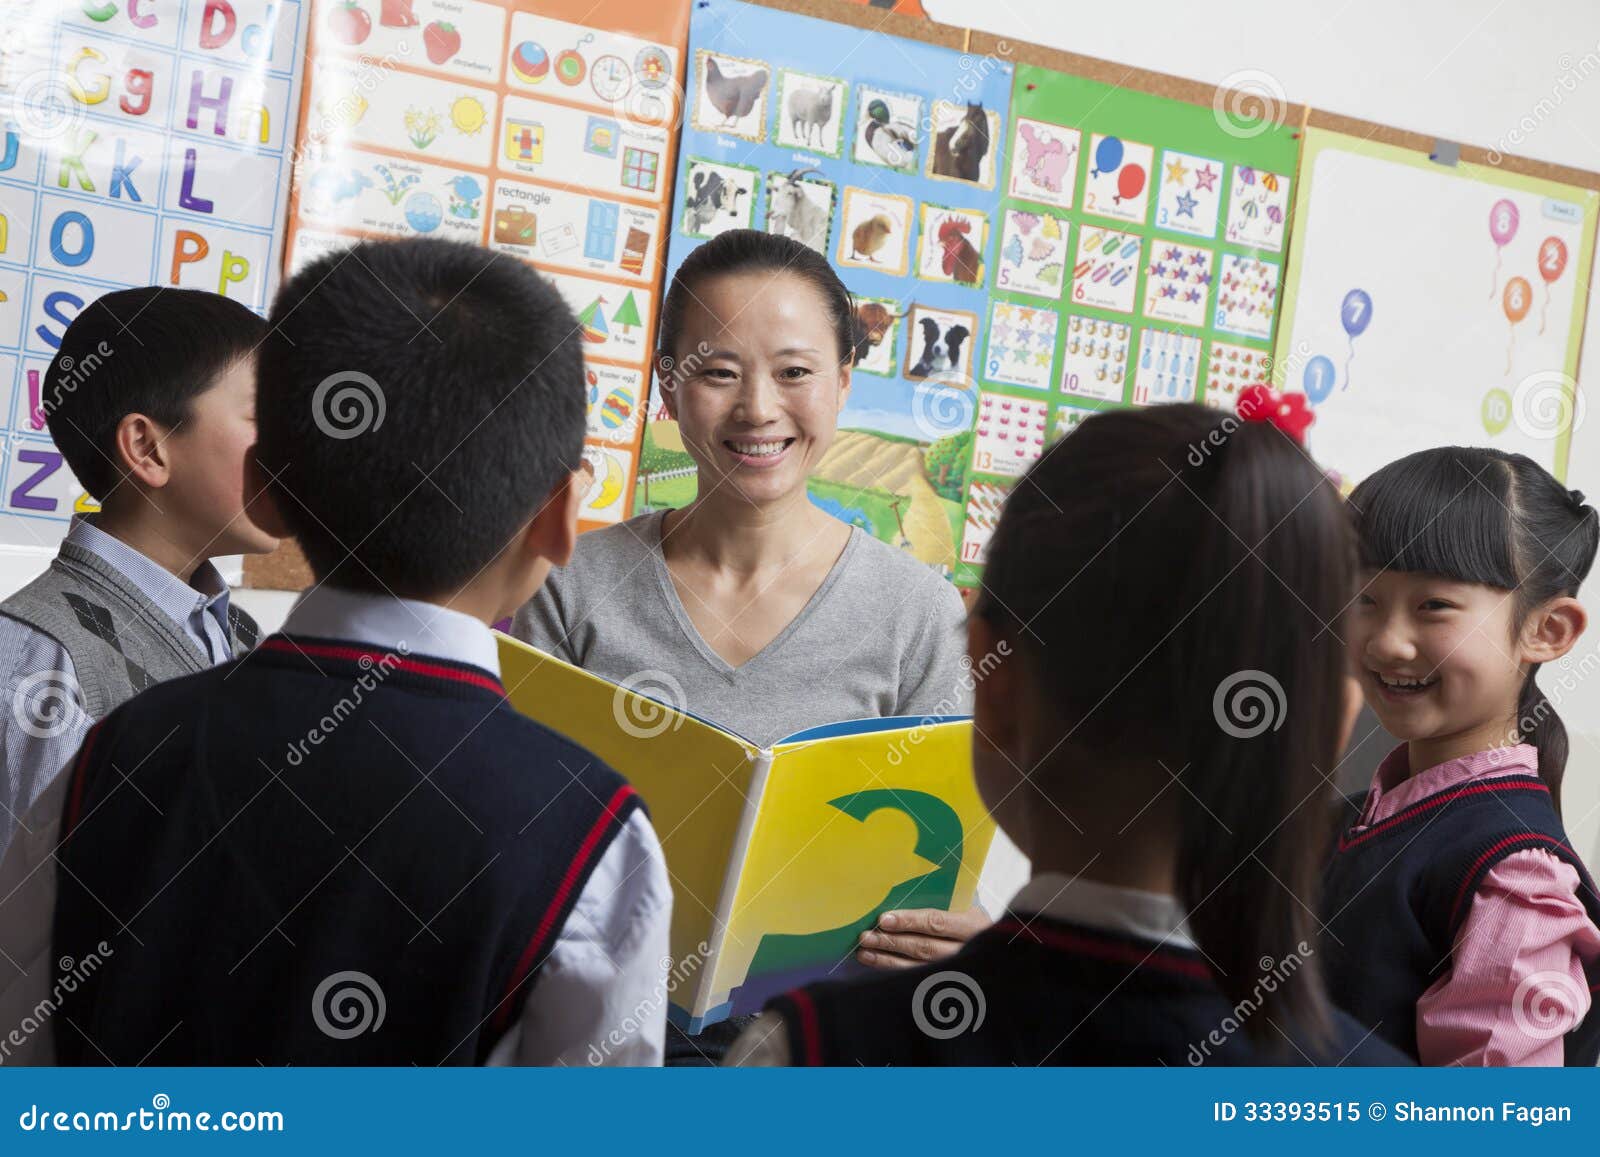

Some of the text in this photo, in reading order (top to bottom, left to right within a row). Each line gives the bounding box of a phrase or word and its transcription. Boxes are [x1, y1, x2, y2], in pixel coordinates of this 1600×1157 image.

[498, 186, 551, 205] rectangle
[1087, 192, 1097, 209] 2
[1160, 207, 1169, 225] 3
[1544, 244, 1560, 271] 2
[1000, 268, 1010, 285] 5
[1074, 282, 1085, 300] 6
[1217, 310, 1226, 327] 8
[1350, 299, 1366, 324] 7
[989, 360, 999, 376] 9
[1063, 373, 1079, 391] 10
[1314, 367, 1323, 390] 1
[1487, 397, 1507, 422] 10
[976, 452, 992, 470] 13
[964, 542, 981, 559] 17
